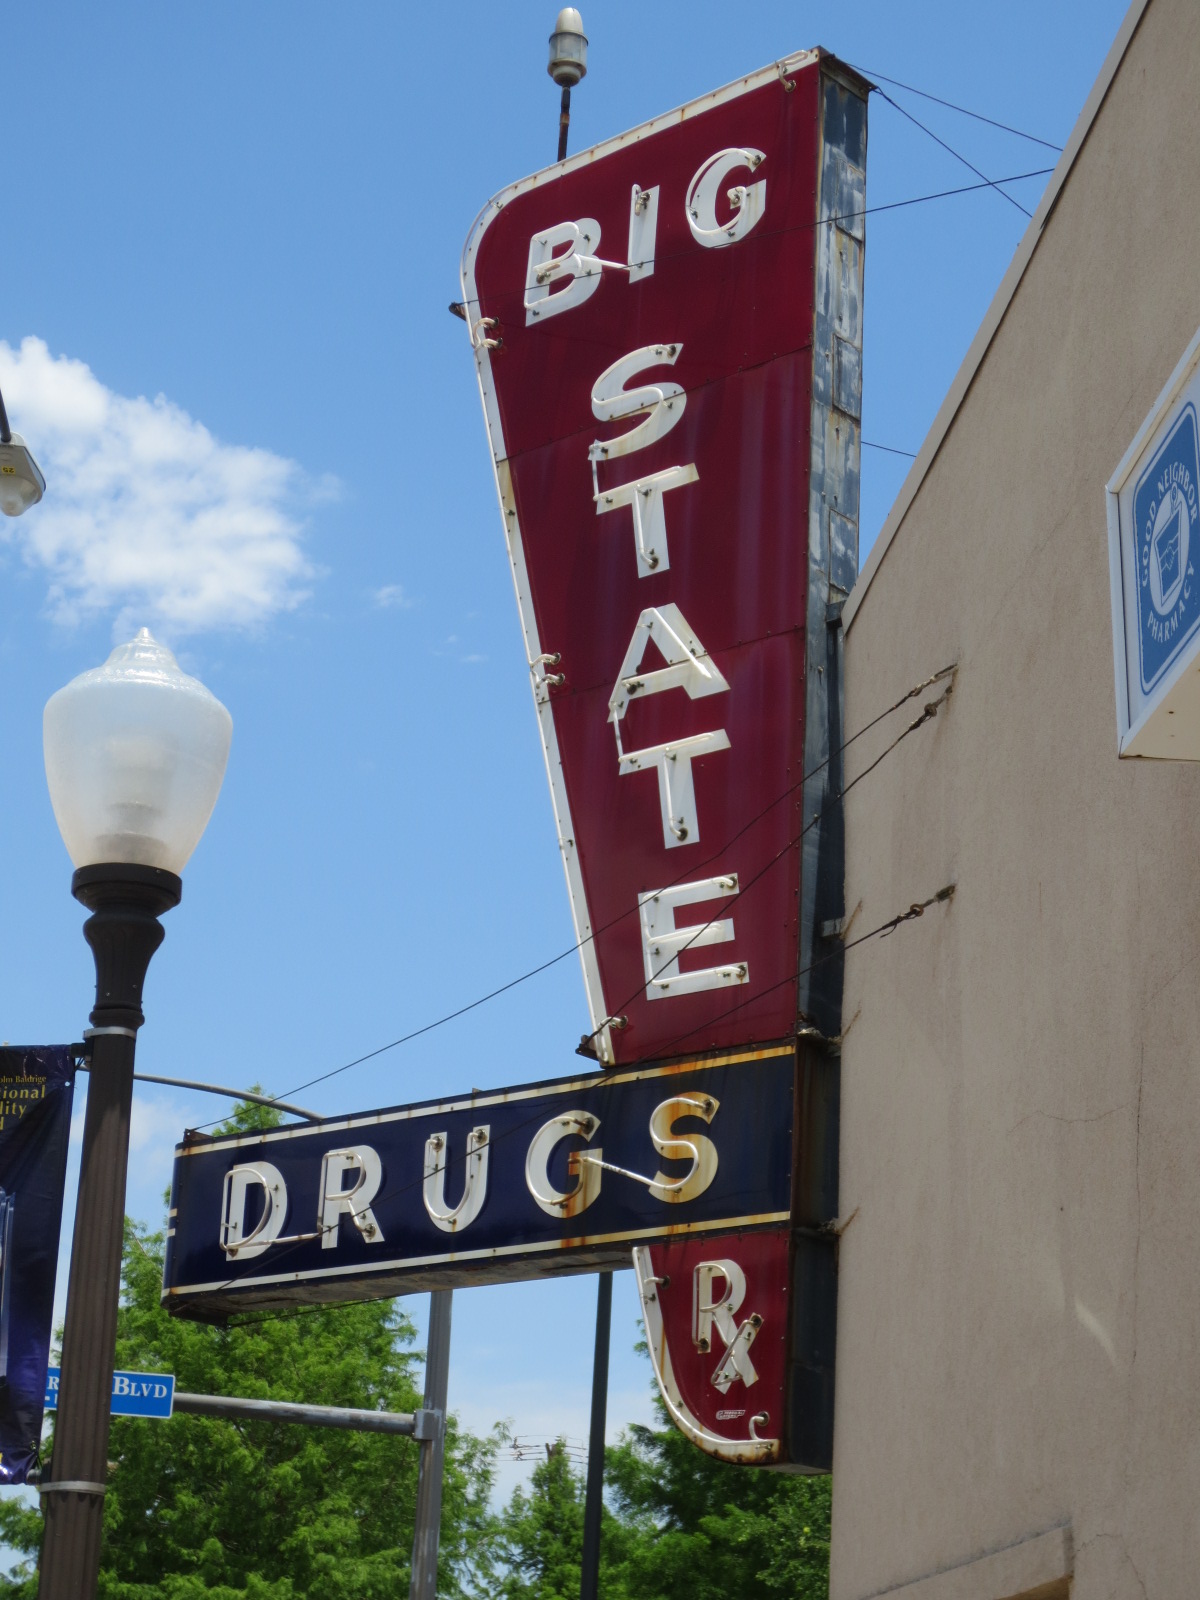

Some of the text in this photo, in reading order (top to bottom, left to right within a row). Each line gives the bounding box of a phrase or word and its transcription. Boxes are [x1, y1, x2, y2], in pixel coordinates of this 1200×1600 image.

[523, 147, 767, 327] BIG
[1142, 461, 1198, 588] GOOD NEIGHBOR
[1147, 560, 1195, 643] PHARMACY
[588, 342, 750, 1000] STATE
[0, 1085, 46, 1099] ional
[15, 1075, 47, 1084] Baldrige
[219, 1091, 720, 1262] DRUGS
